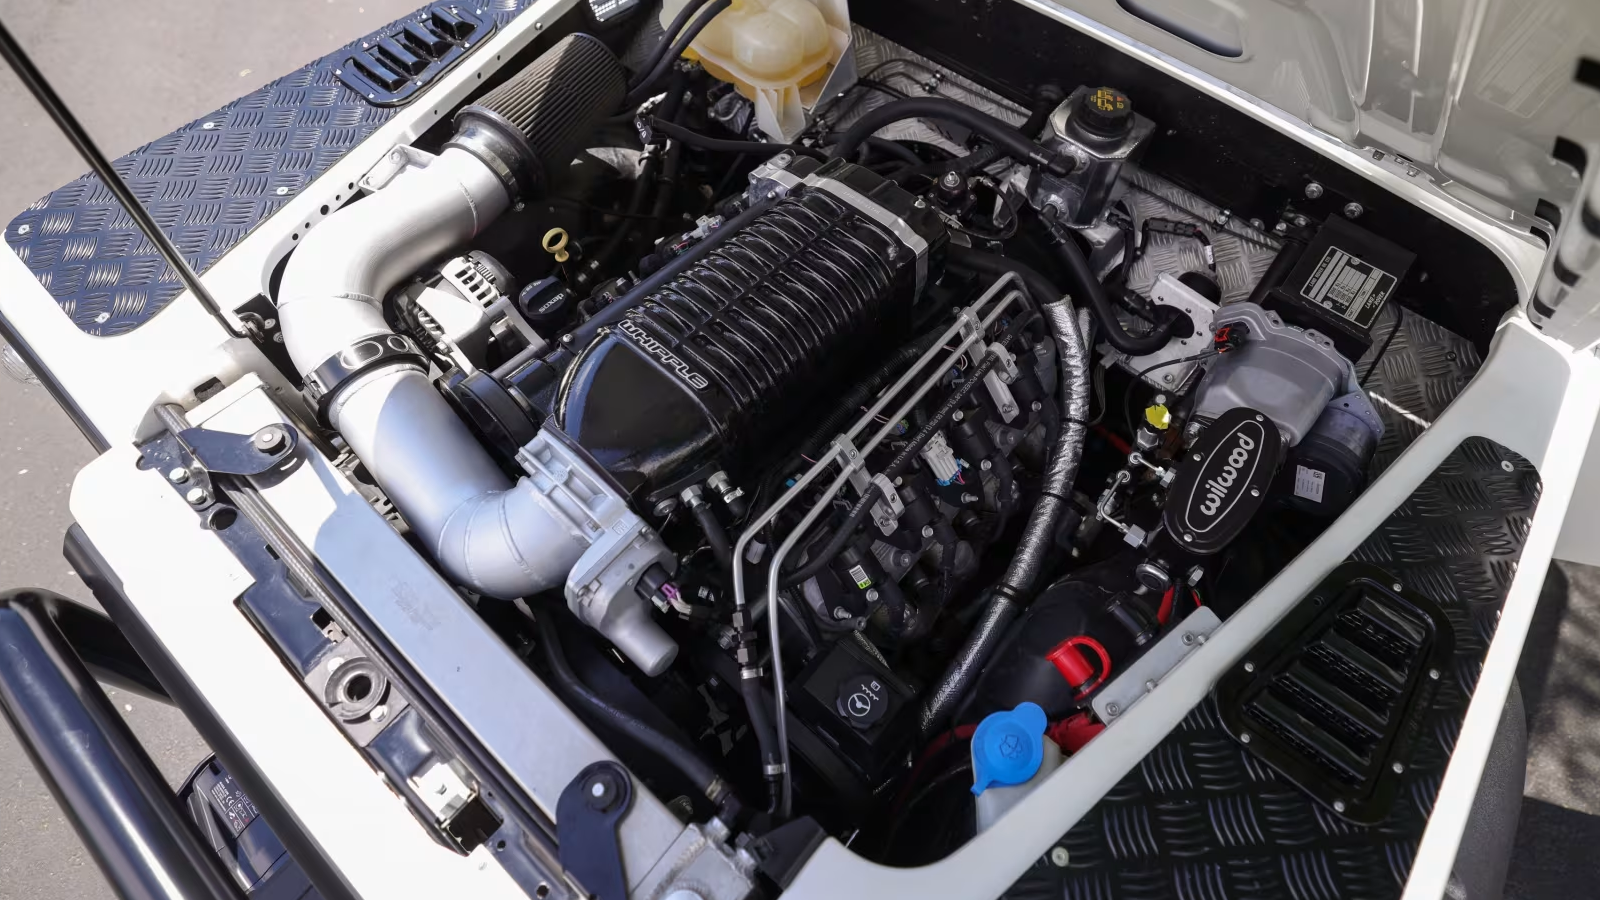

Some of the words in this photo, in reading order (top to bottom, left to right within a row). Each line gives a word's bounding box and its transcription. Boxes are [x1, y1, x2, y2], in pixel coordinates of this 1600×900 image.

[538, 292, 565, 314] dexos
[618, 319, 709, 389] WHIPPLE
[1200, 432, 1255, 516] wilwood
